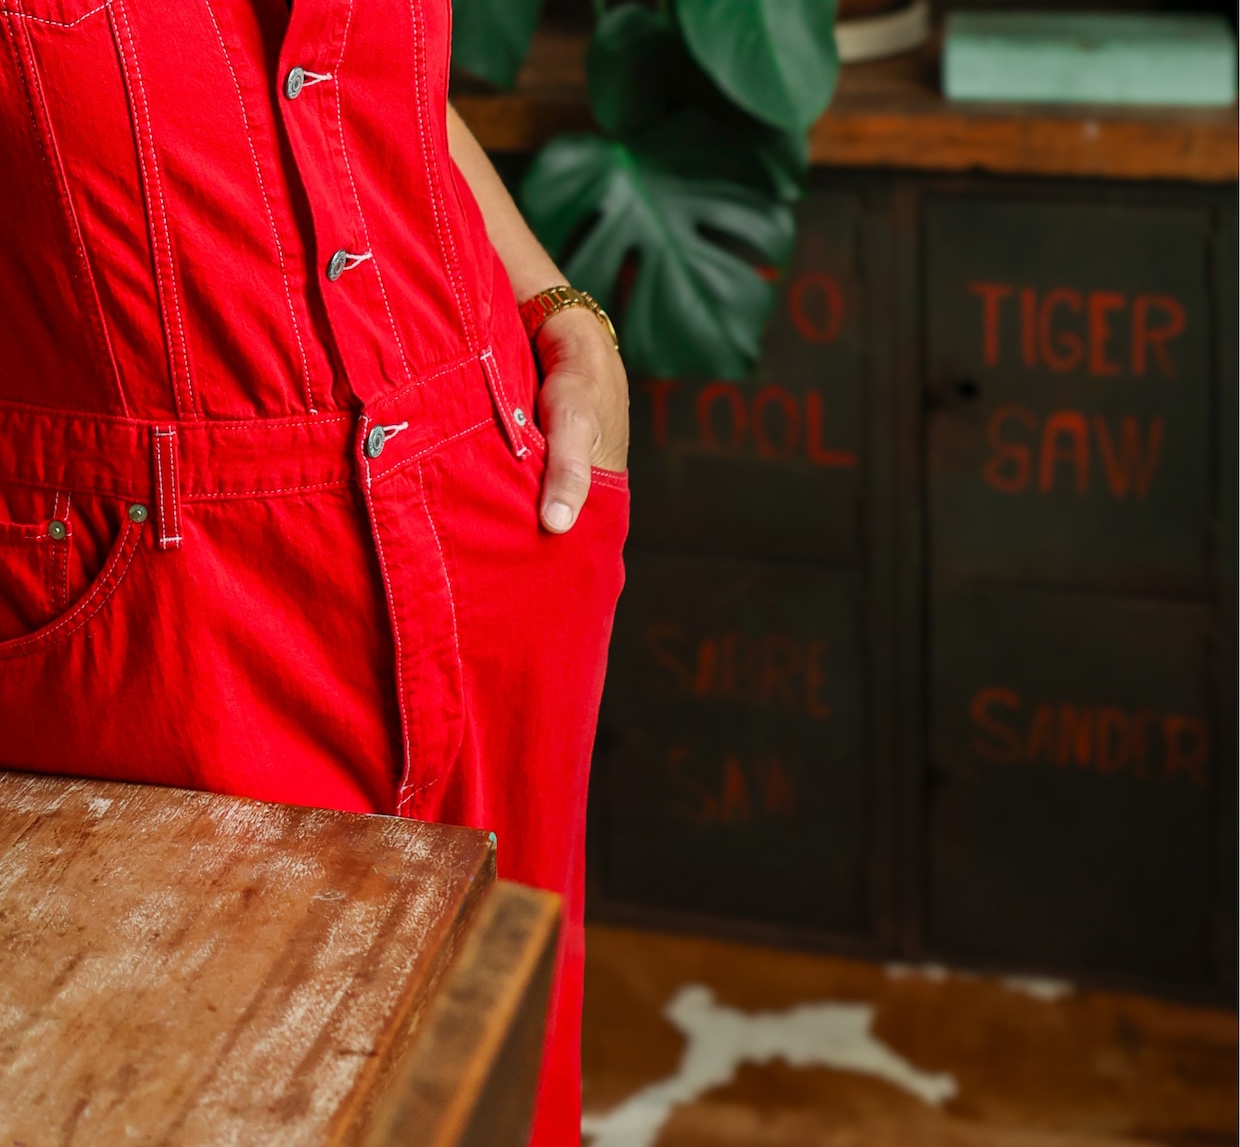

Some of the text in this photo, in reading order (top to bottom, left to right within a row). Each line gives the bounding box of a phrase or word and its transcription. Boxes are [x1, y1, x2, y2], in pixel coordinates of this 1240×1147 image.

[970, 281, 1185, 376] TIGER
[642, 379, 856, 466] TOOL
[985, 404, 1163, 498] SAW
[971, 687, 1208, 785] SANDER
